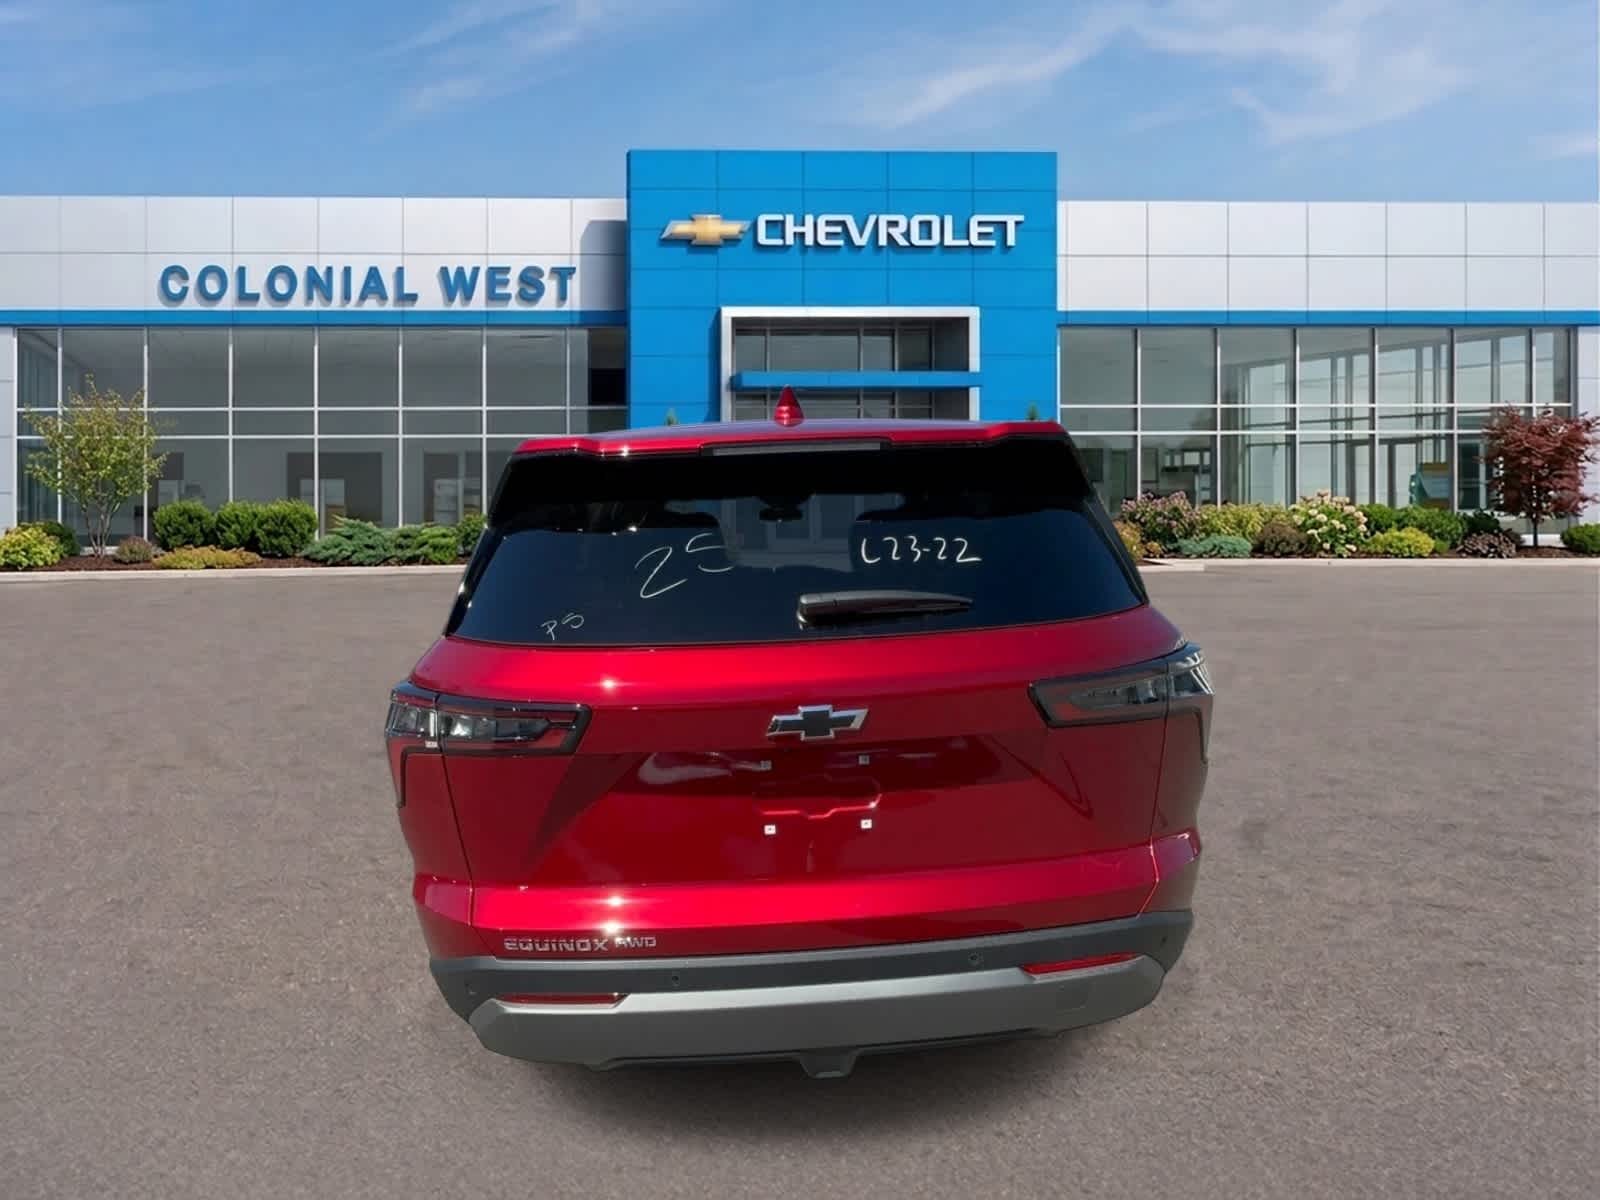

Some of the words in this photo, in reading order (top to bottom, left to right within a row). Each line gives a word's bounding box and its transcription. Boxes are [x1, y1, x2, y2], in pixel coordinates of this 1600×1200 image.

[756, 214, 1025, 248] CHEVROLET
[160, 265, 418, 302] COLONIAL
[440, 265, 577, 302] WEST
[503, 937, 608, 952] EQUINOX
[614, 936, 657, 949] AWD
